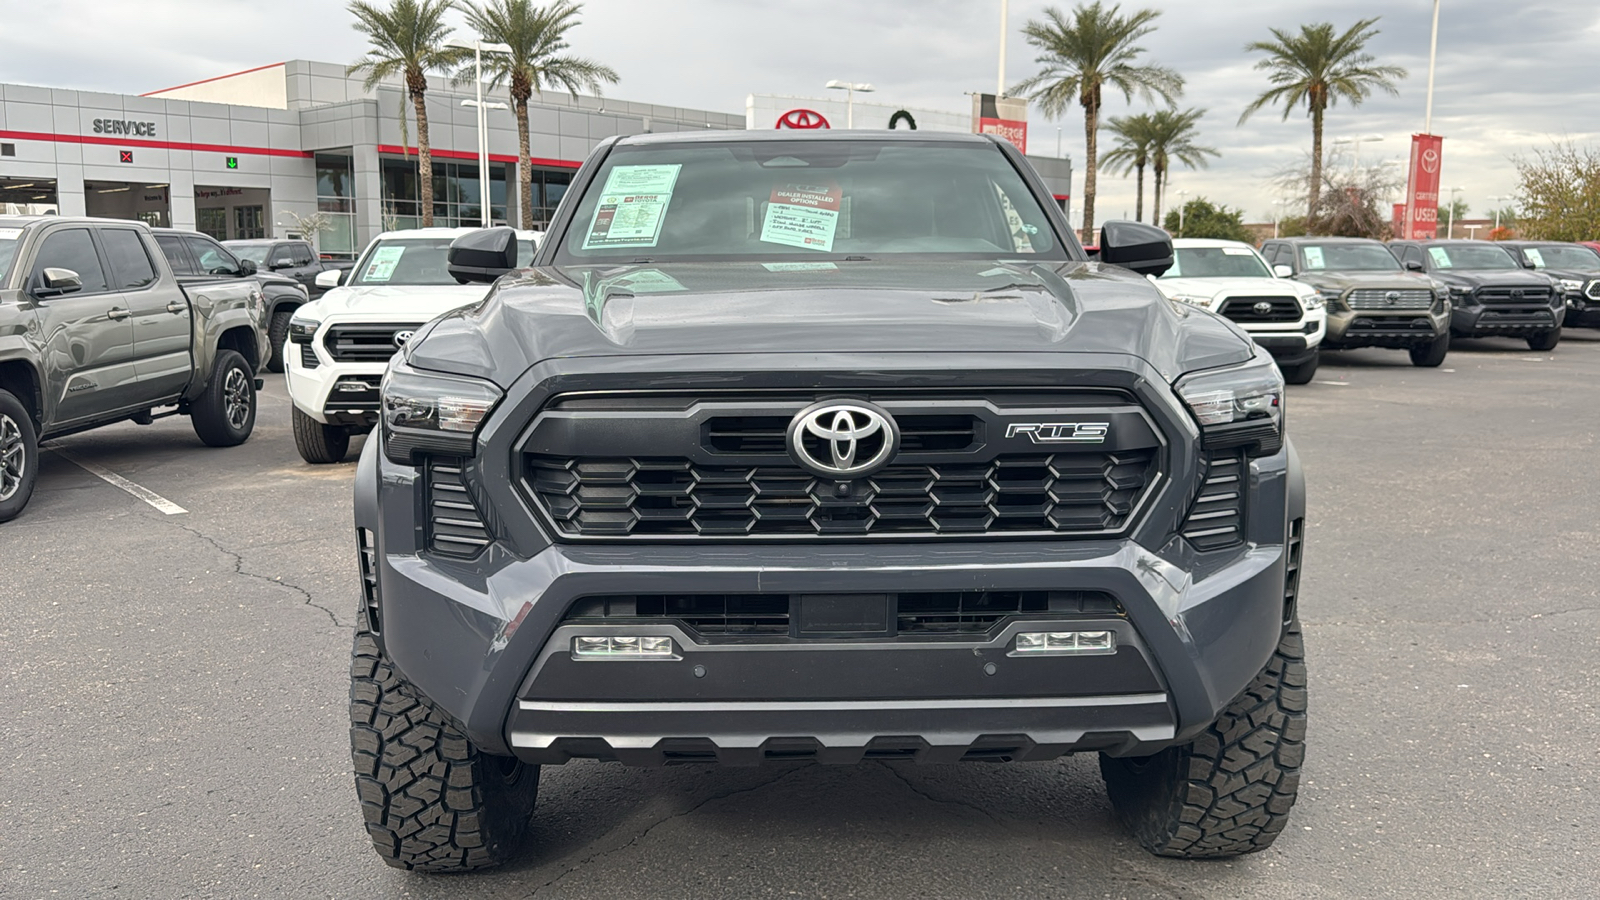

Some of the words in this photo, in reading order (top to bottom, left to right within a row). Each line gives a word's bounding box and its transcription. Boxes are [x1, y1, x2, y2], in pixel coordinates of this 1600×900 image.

[92, 118, 157, 137] SERVICE
[996, 123, 1023, 139] BERGE
[777, 191, 801, 199] DEALER
[801, 192, 834, 203] INSTALLED
[790, 197, 818, 206] OPTIONS
[1414, 207, 1438, 222] USED
[1005, 422, 1110, 444] RTS
